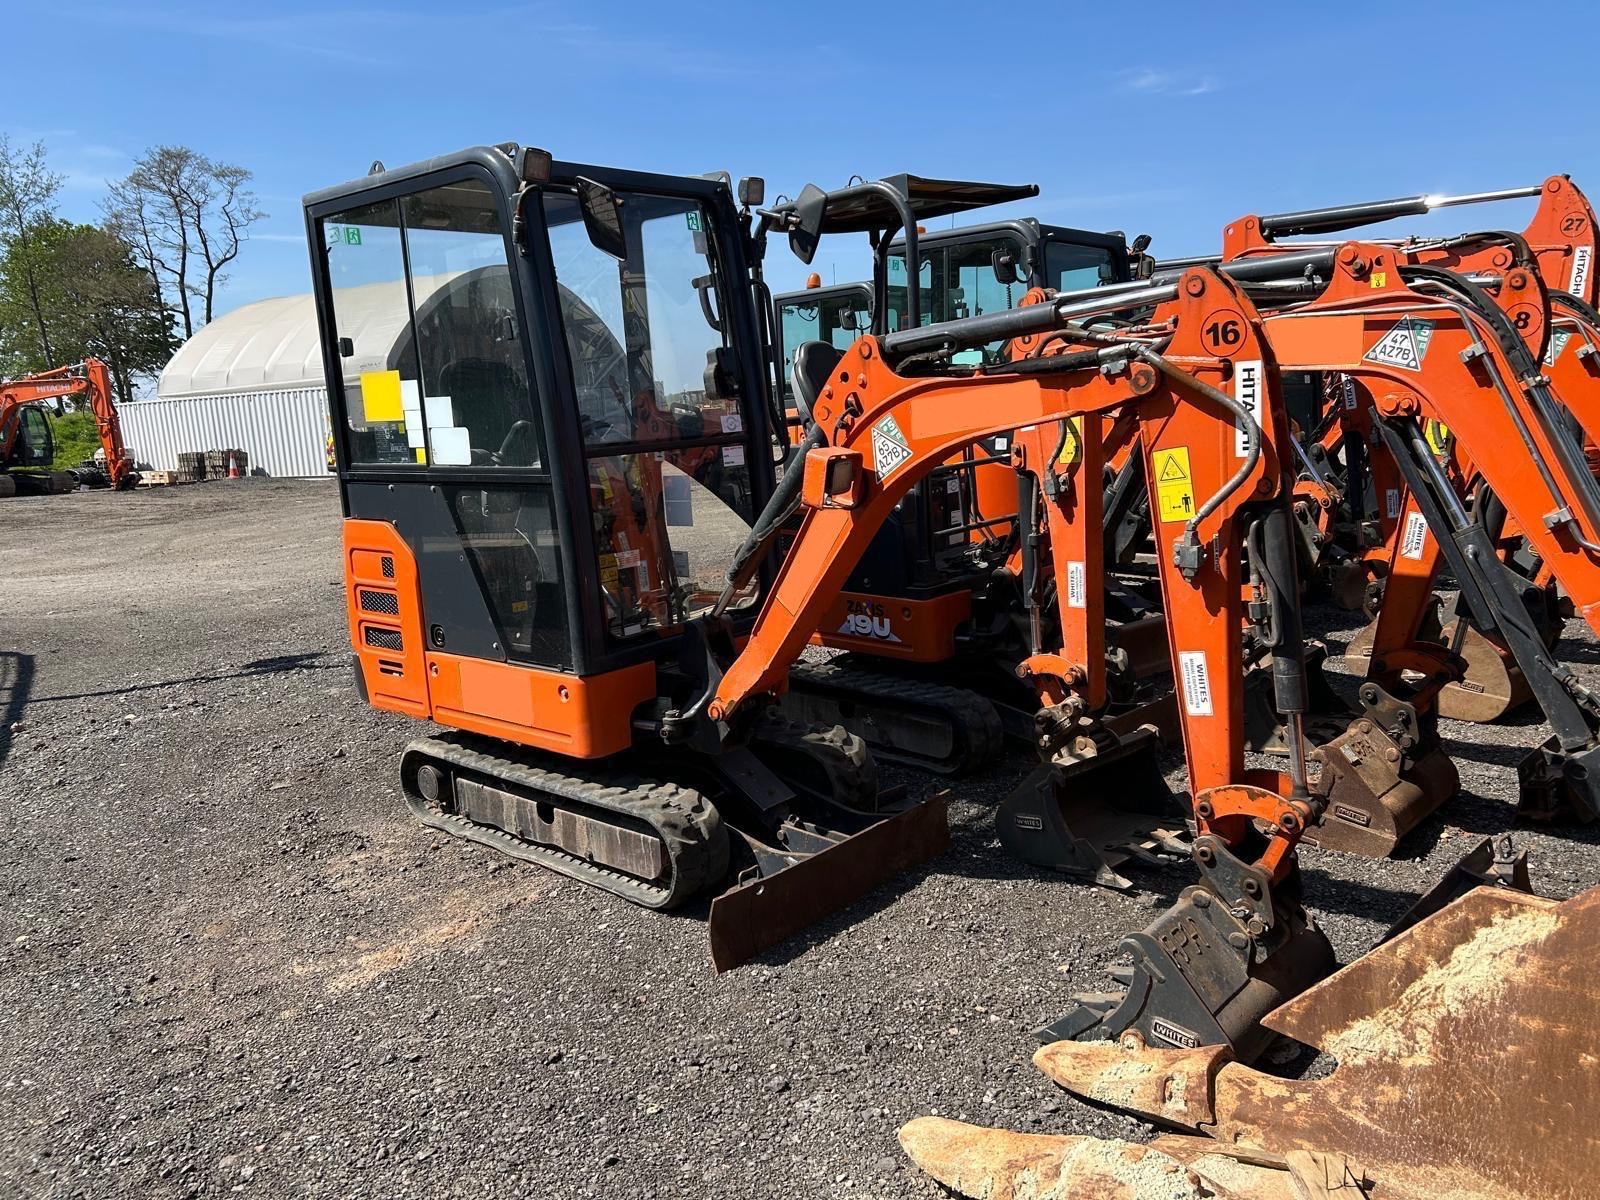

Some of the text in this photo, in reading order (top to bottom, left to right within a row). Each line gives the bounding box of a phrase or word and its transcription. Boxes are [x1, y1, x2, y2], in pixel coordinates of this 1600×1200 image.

[1563, 218, 1585, 232] 27
[1572, 249, 1588, 295] HITACHI
[1514, 311, 1530, 329] 8
[1206, 320, 1240, 347] 16
[1391, 333, 1408, 346] 47
[1379, 344, 1411, 361] AZ7B
[36, 384, 71, 393] HITACHI
[1242, 367, 1255, 451] HITAHI
[878, 440, 890, 456] 65
[878, 447, 901, 471] AZ7B
[1414, 522, 1425, 551] WHITES
[847, 613, 891, 639] 19U
[1196, 663, 1208, 703] WHITES
[1156, 1024, 1194, 1047] WHITES
